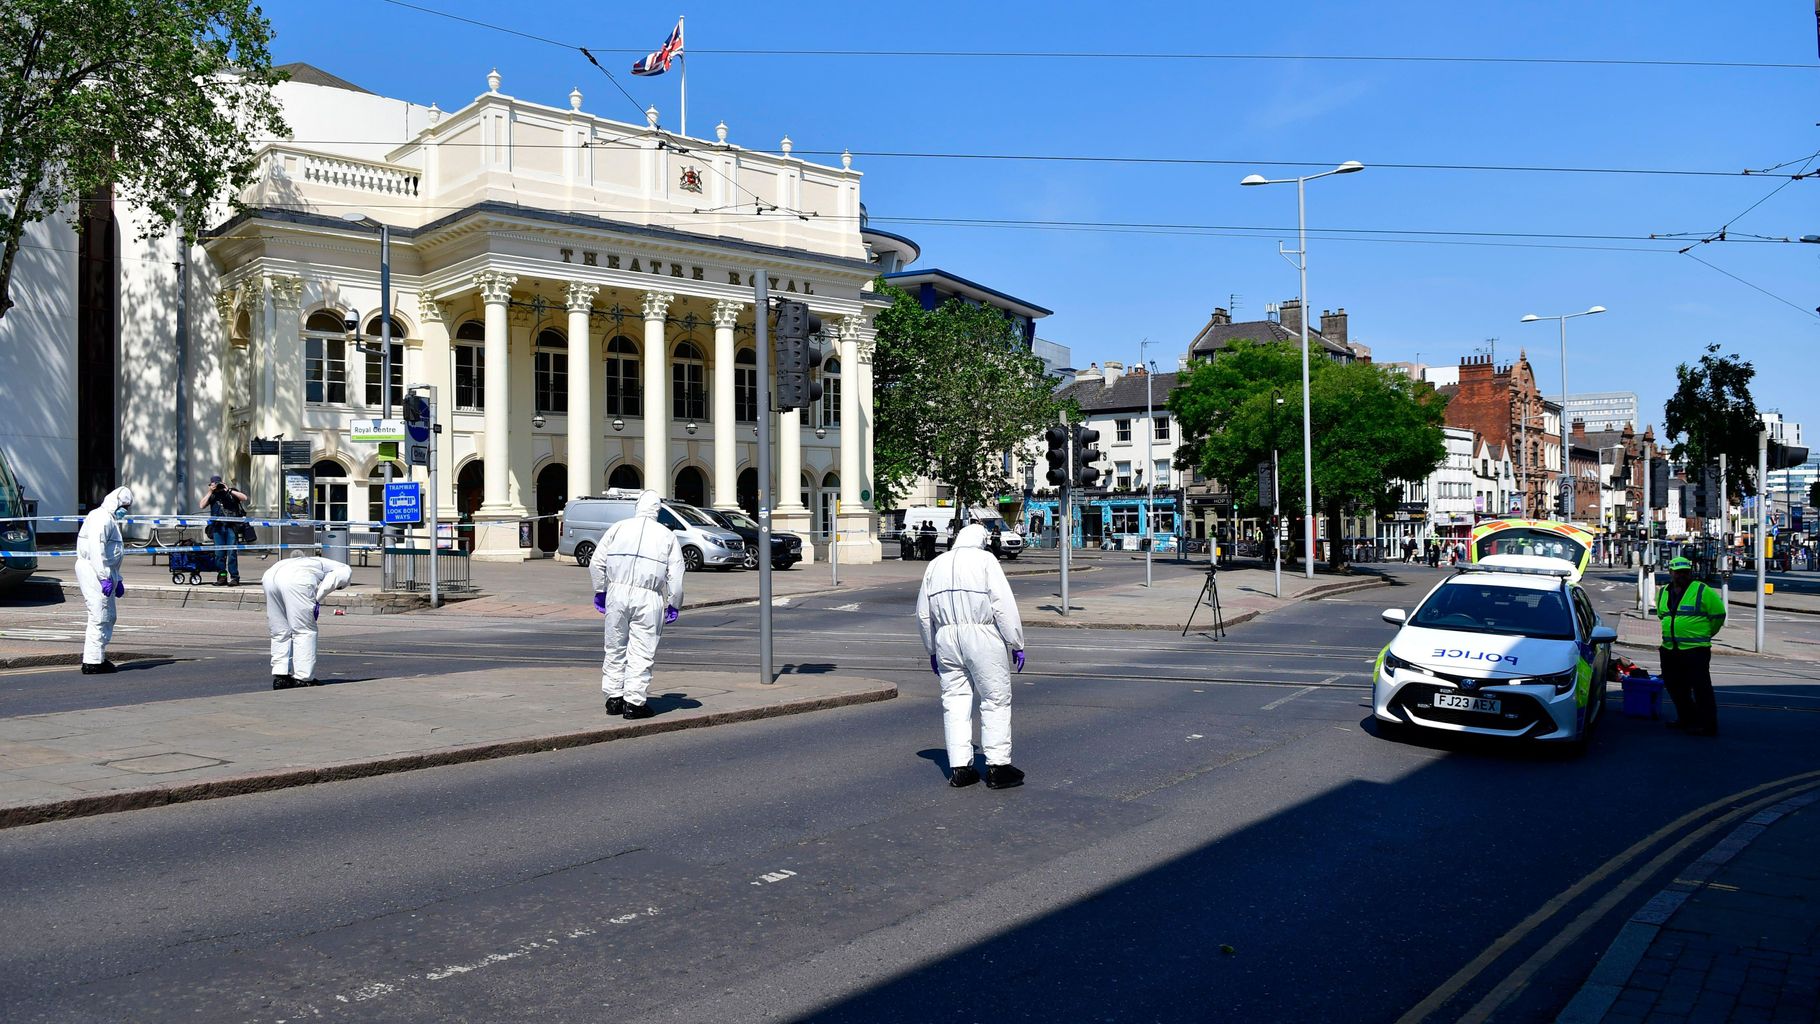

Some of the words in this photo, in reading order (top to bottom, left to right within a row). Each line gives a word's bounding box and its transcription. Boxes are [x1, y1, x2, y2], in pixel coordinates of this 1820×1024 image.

[560, 247, 704, 281] THEATRE
[355, 426, 371, 434] Royal
[1439, 695, 1470, 708] FJ23
[1472, 700, 1497, 712] AEX
